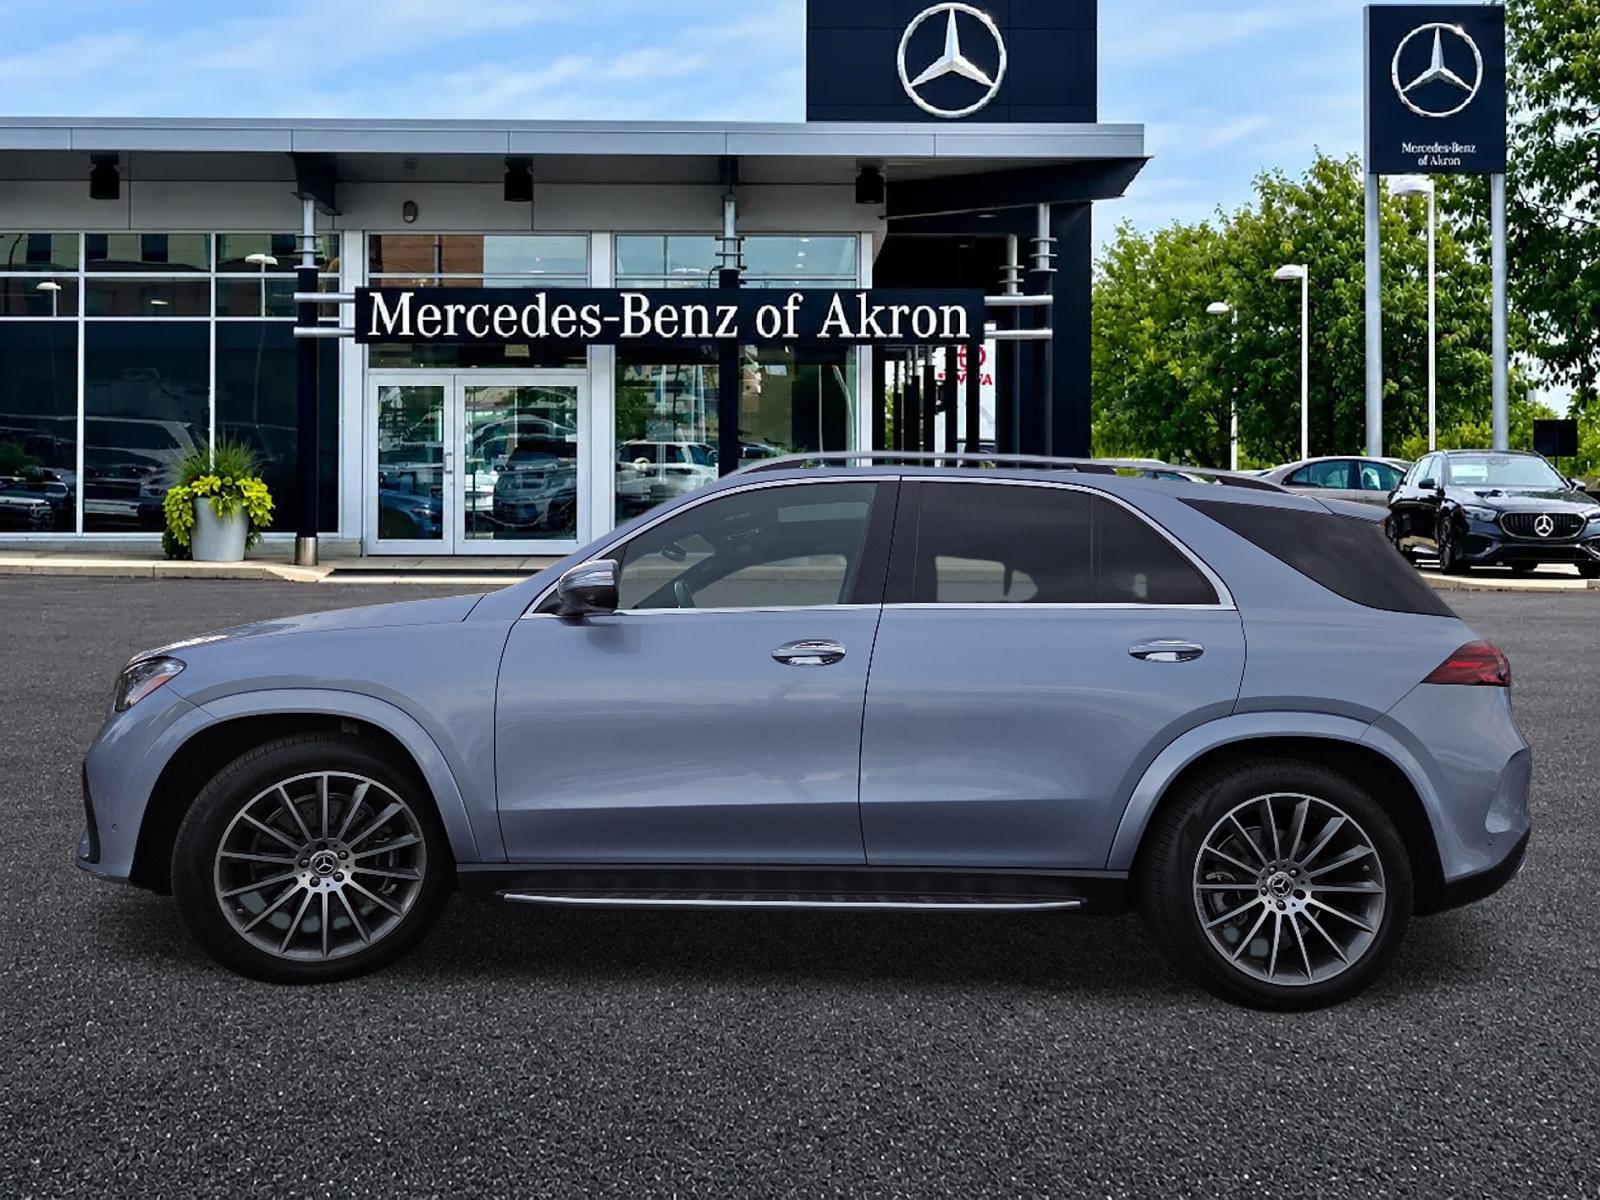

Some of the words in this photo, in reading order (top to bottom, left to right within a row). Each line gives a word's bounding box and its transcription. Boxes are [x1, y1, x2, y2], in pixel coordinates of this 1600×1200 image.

[1417, 154, 1429, 166] of
[1430, 154, 1461, 166] Akron
[367, 291, 738, 338] Mercedes-Benz
[755, 292, 804, 338] of
[816, 291, 971, 338] Akron
